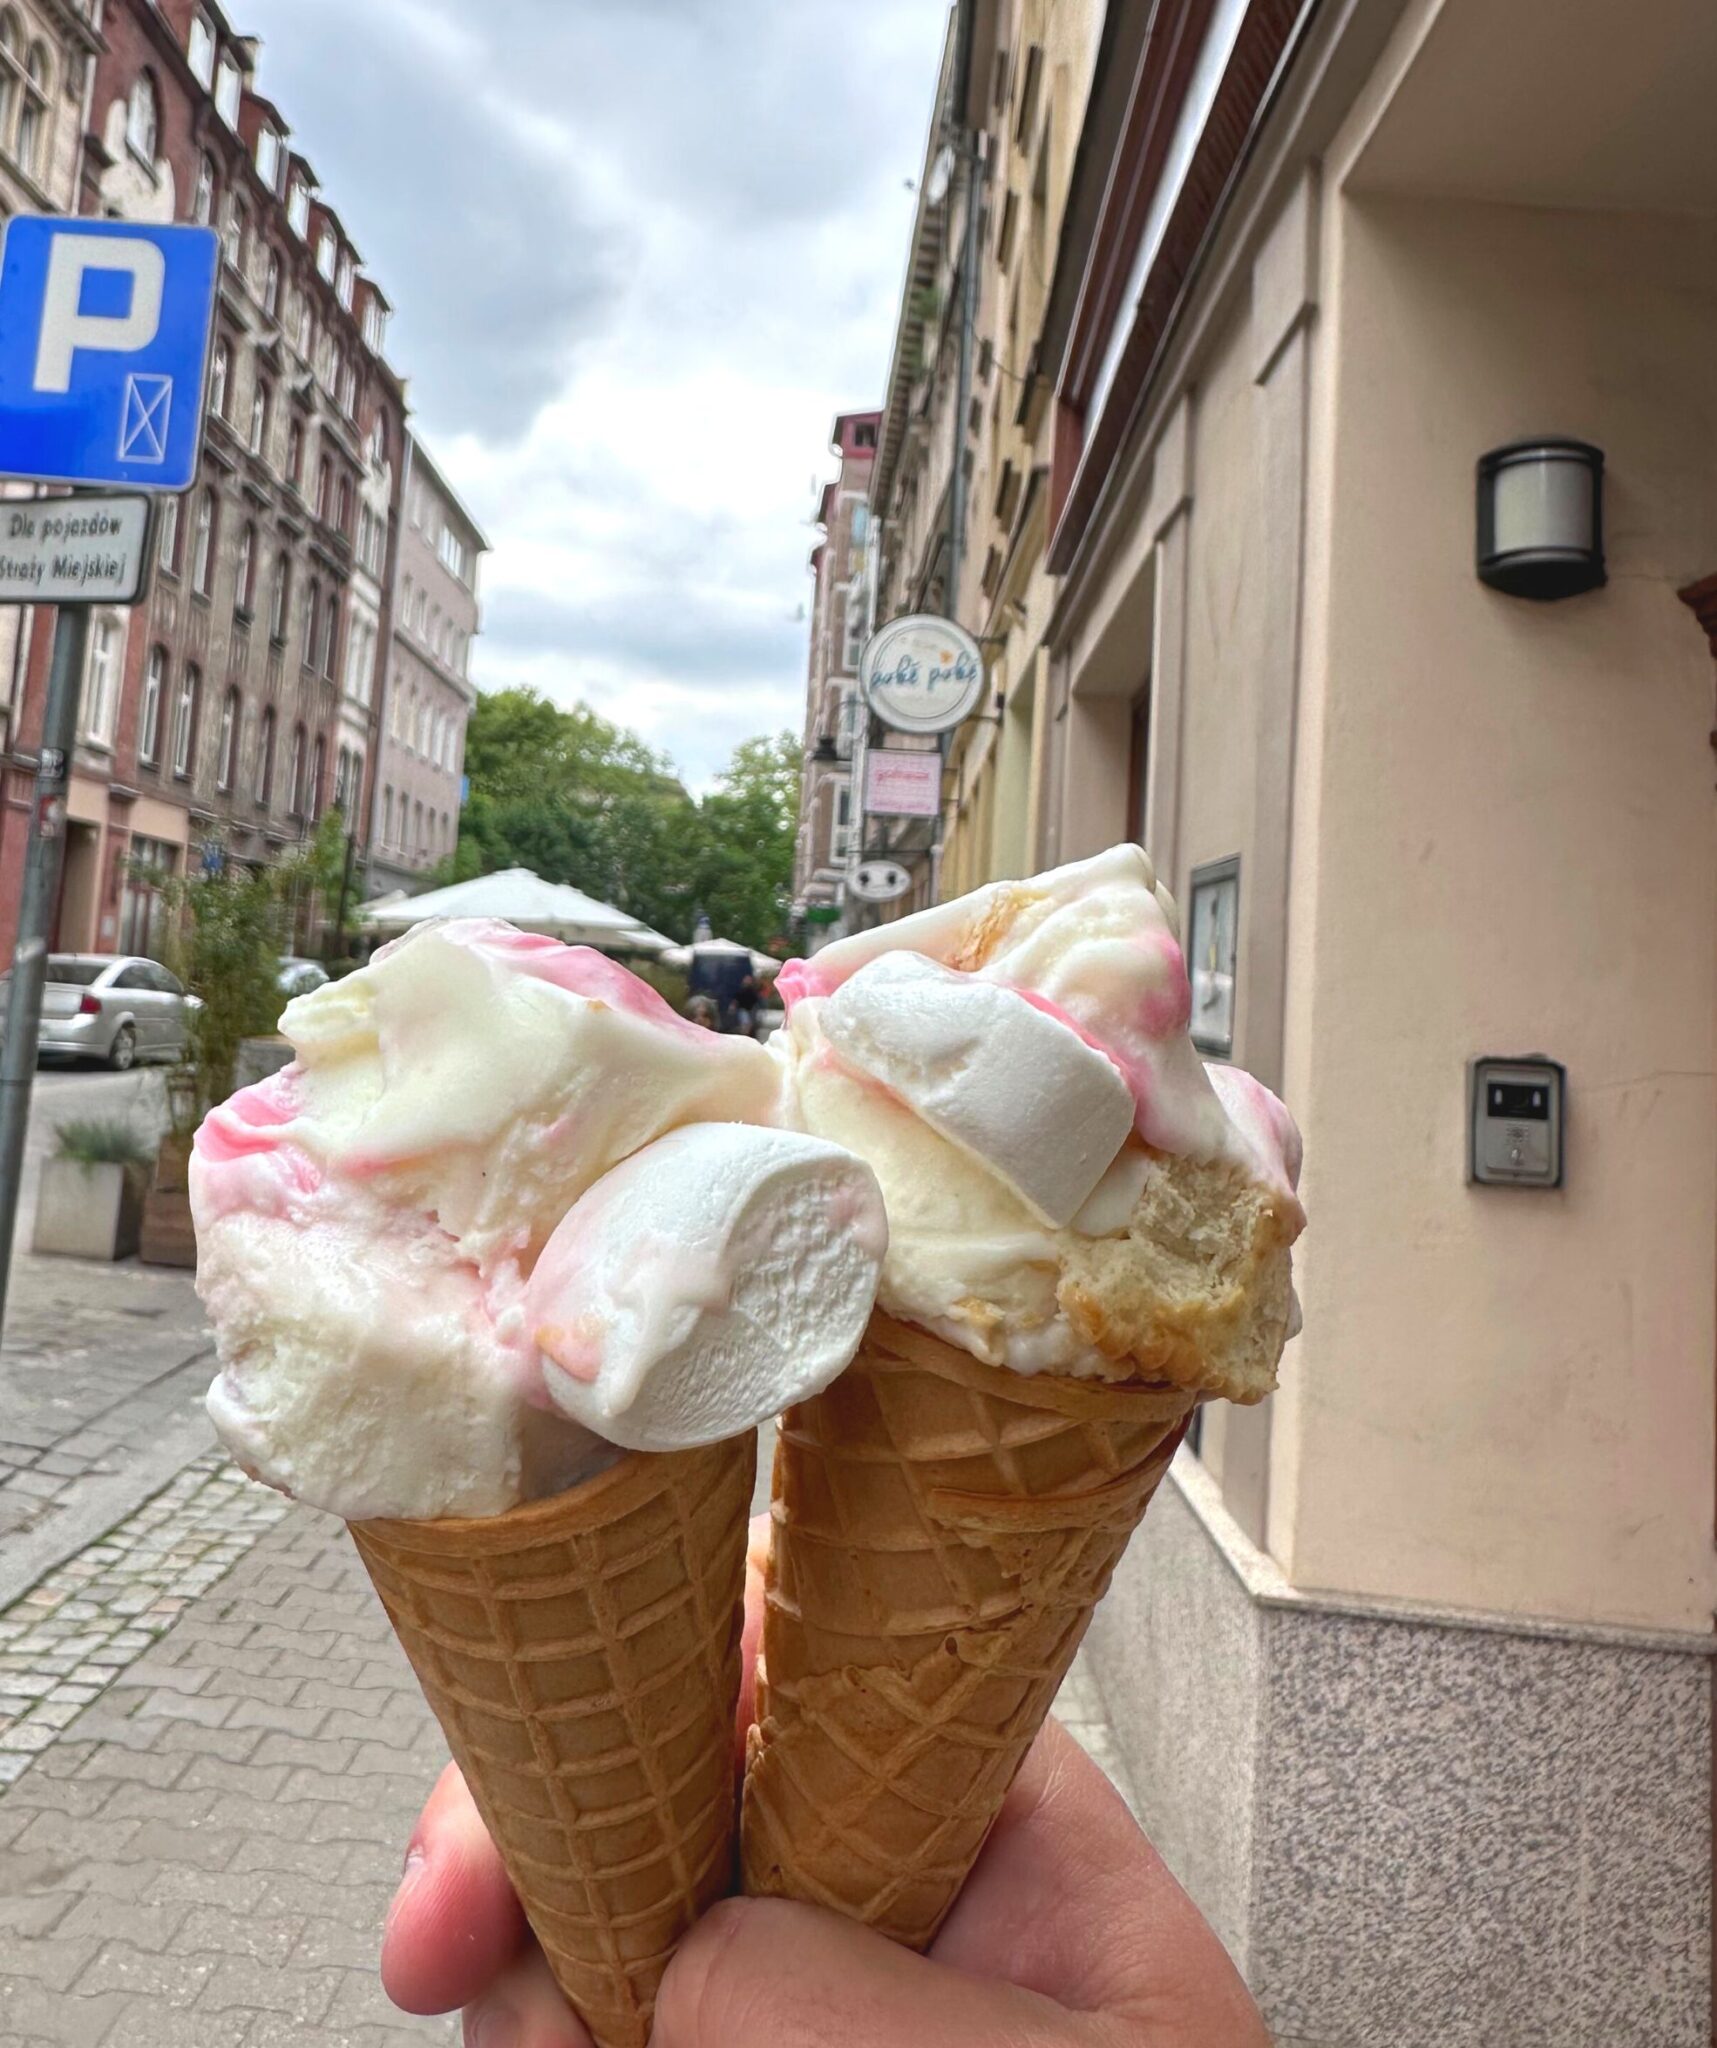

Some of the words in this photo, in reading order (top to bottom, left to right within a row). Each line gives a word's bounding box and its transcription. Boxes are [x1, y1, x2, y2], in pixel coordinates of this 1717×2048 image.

[33, 232, 165, 393] P
[10, 513, 35, 538] Dla
[41, 509, 121, 542] pojazdów
[52, 553, 126, 587] Miejskiej
